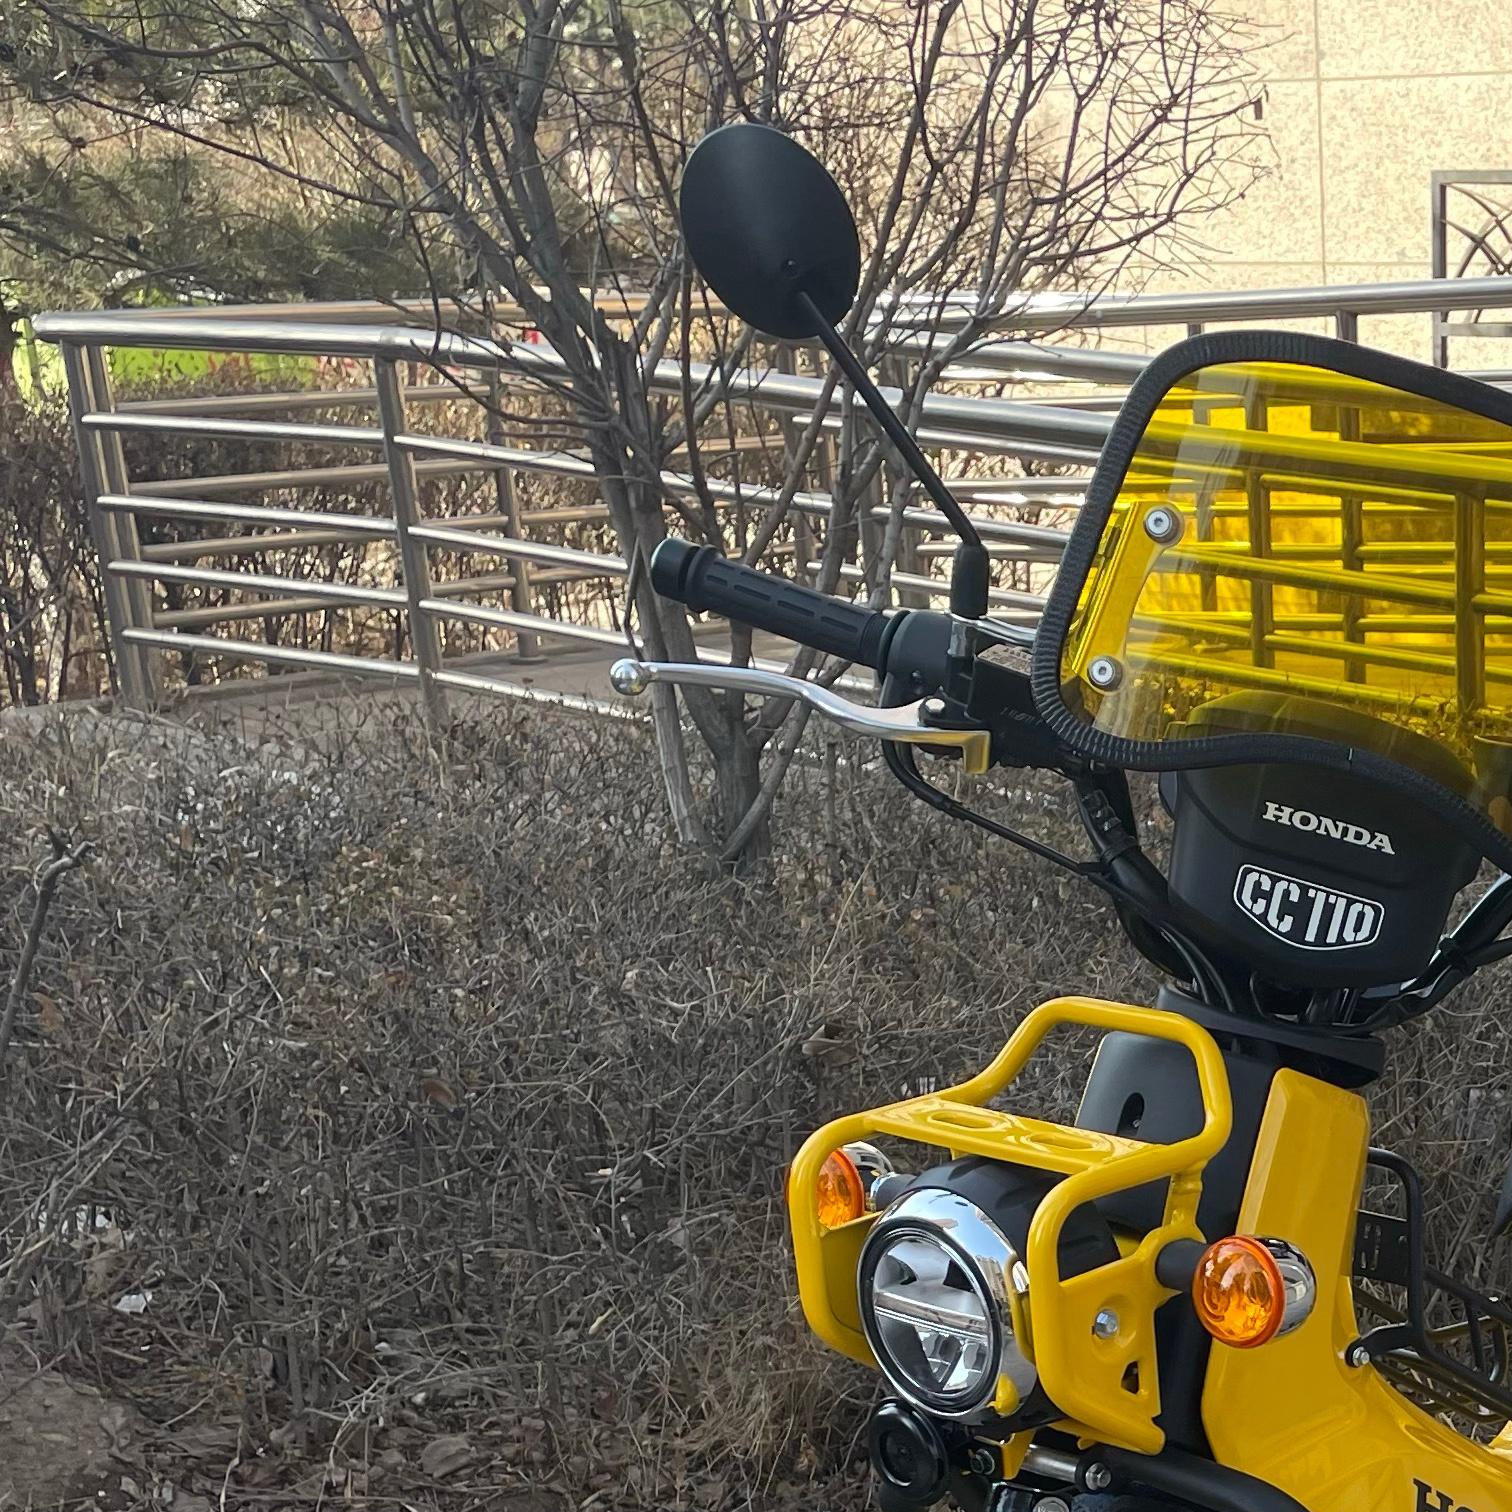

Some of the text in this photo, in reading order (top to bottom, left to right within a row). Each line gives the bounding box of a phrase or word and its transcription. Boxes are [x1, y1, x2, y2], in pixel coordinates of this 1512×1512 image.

[1262, 801, 1396, 855] HONDA
[1241, 871, 1375, 944] CC 110
